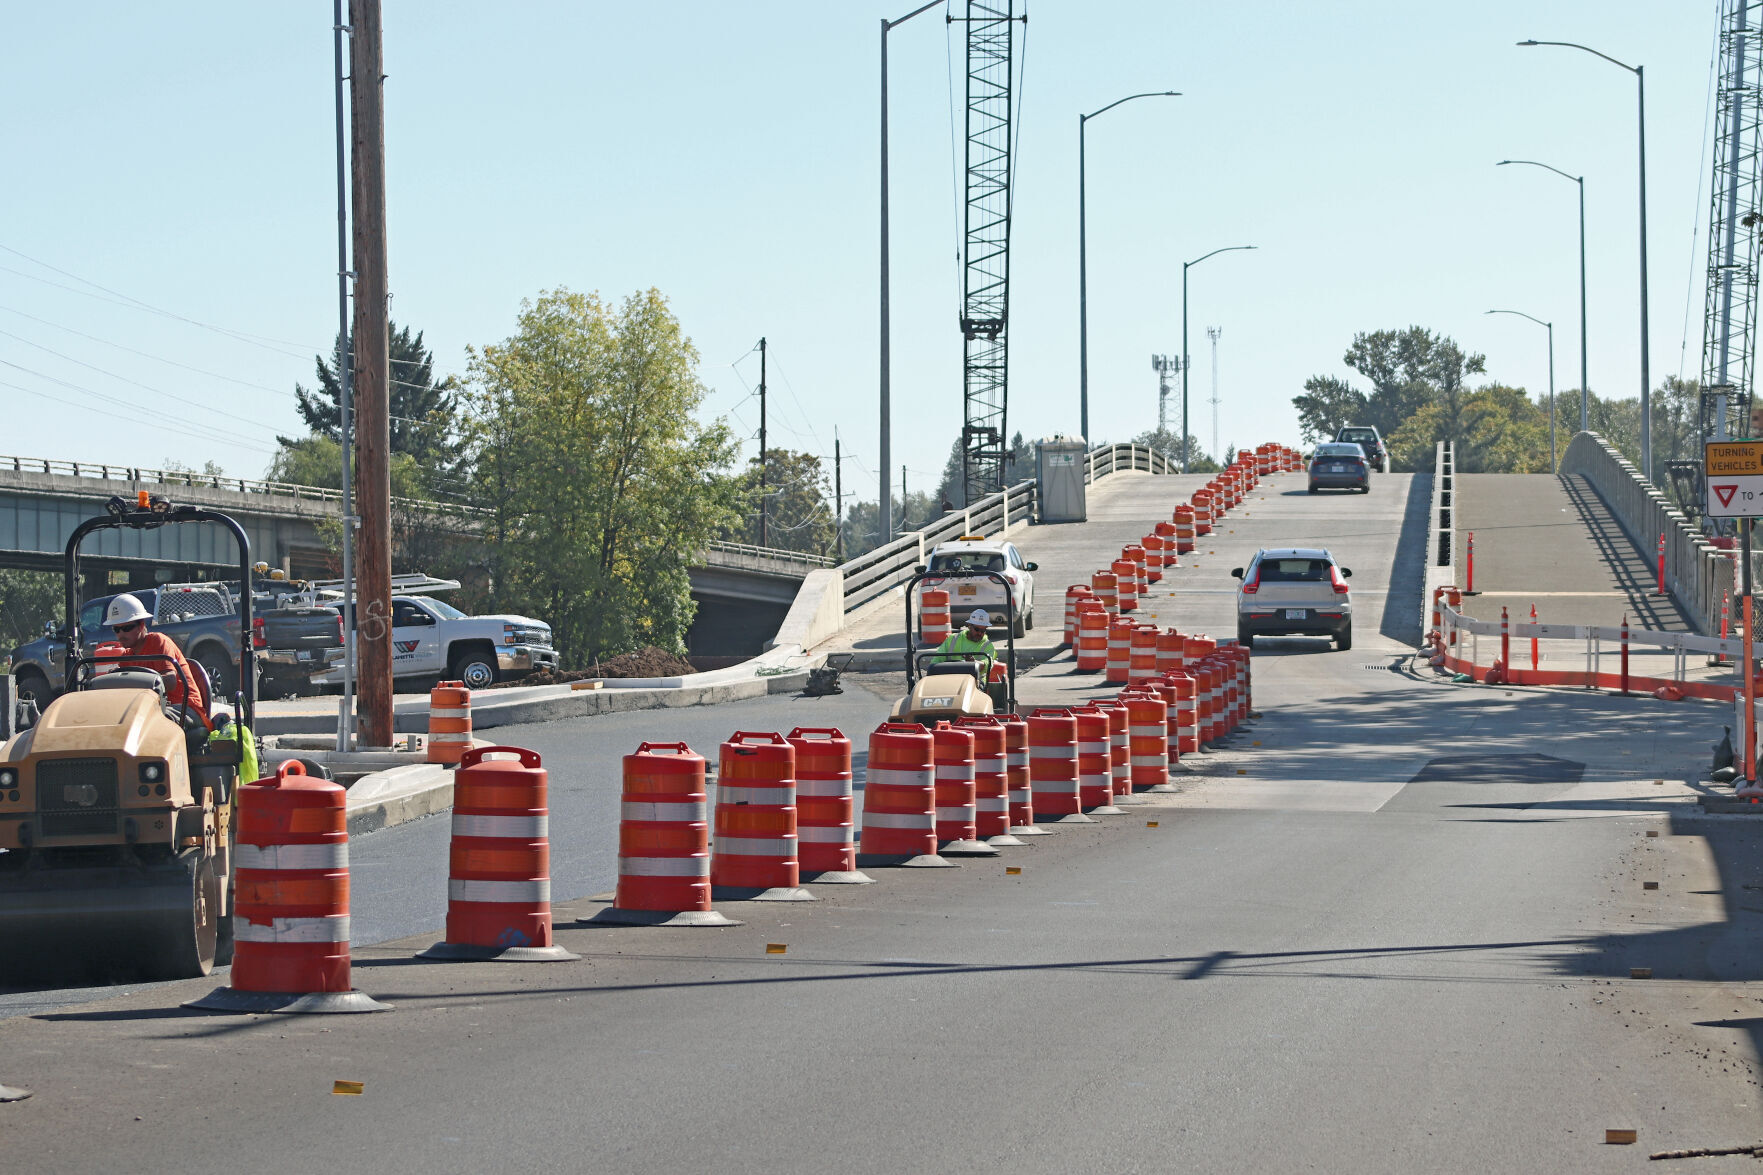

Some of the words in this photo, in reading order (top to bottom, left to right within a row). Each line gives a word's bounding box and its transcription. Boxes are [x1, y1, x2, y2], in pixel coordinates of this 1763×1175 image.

[1712, 447, 1755, 457] TURNING
[1711, 461, 1757, 471] VEHICLES
[1741, 491, 1754, 501] TO
[923, 697, 951, 707] CAT
